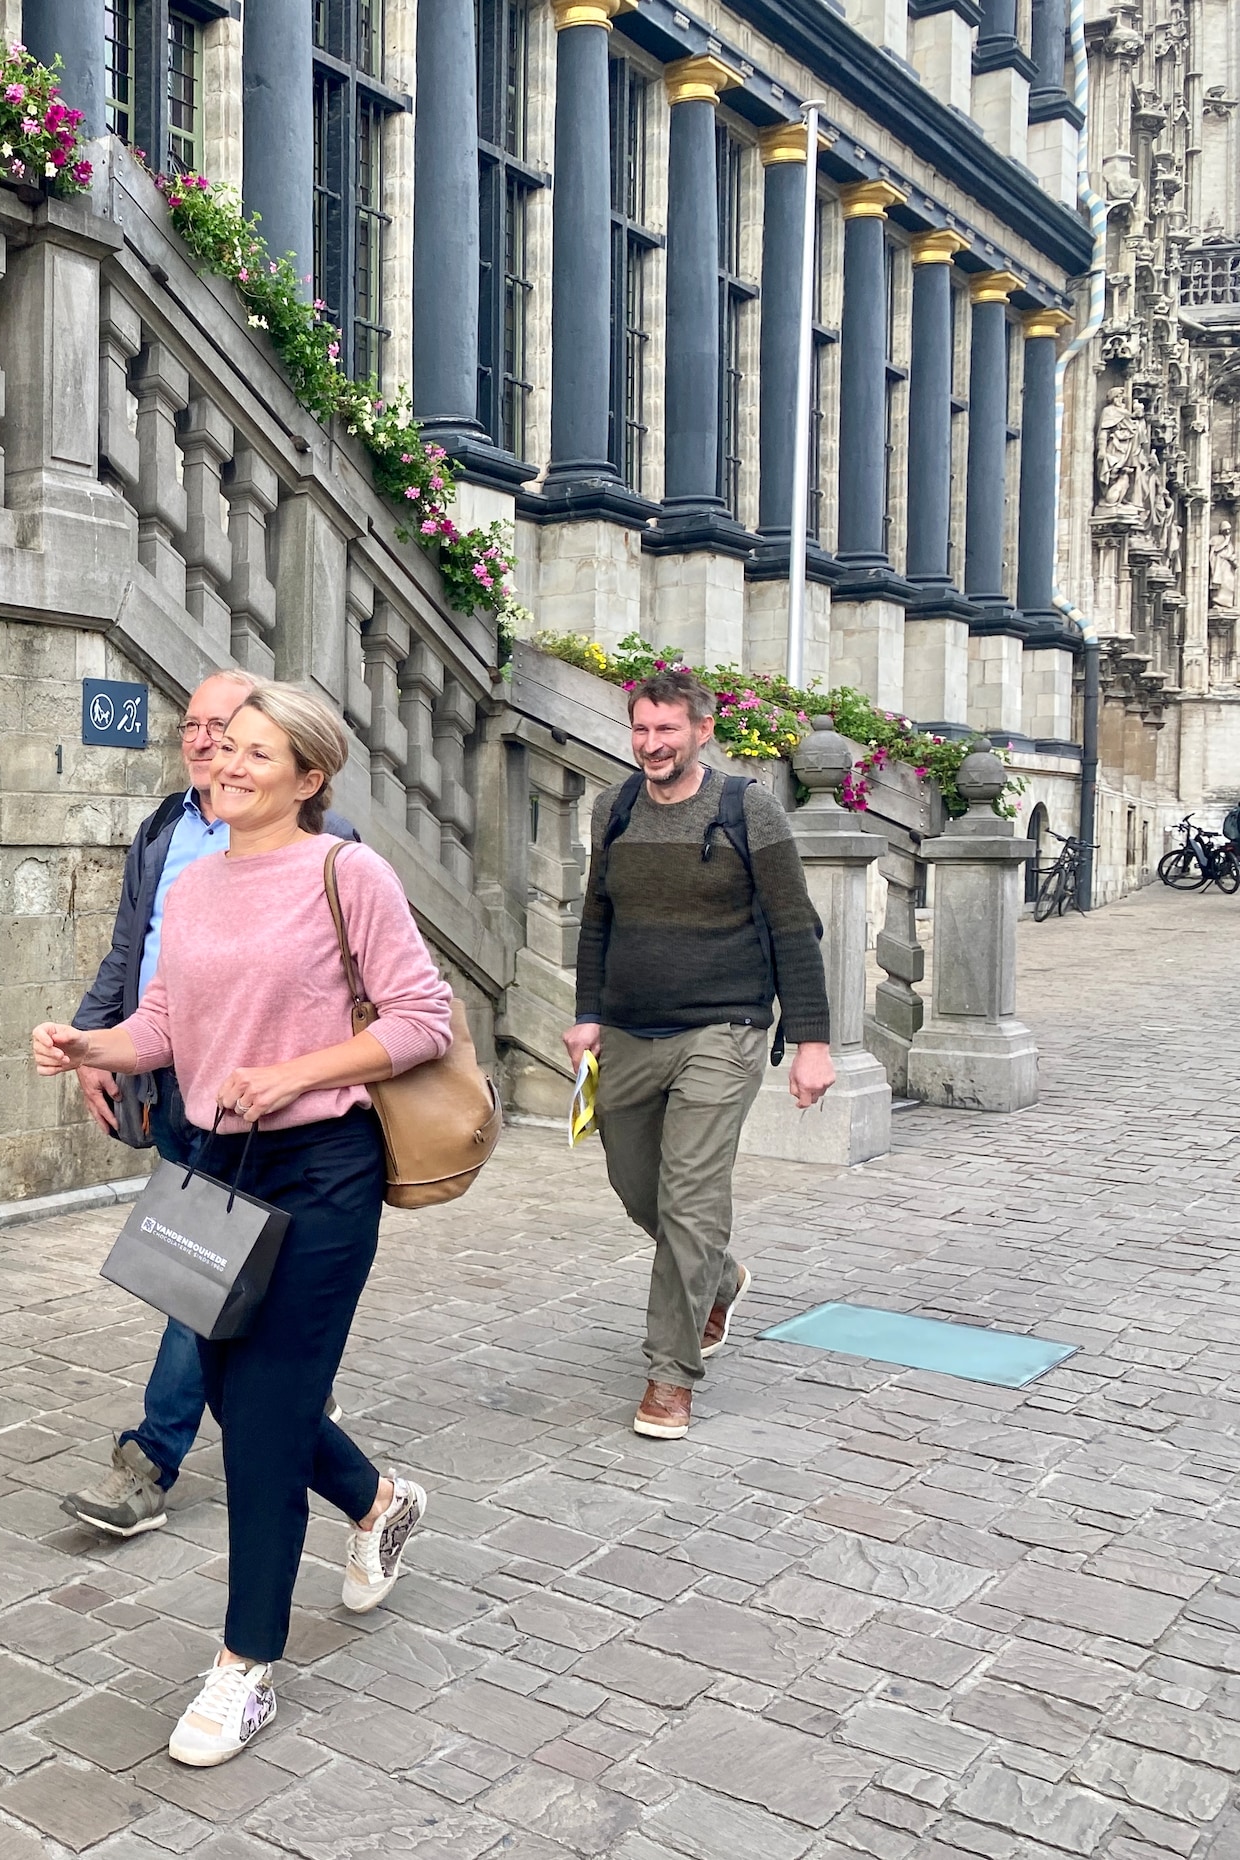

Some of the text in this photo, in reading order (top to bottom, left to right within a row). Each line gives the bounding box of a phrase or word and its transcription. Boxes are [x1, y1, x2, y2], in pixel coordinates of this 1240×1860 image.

[55, 744, 63, 774] 1
[152, 1230, 192, 1255] CHOCOLATERIE
[156, 1222, 228, 1267] VANDENBOUHEDE
